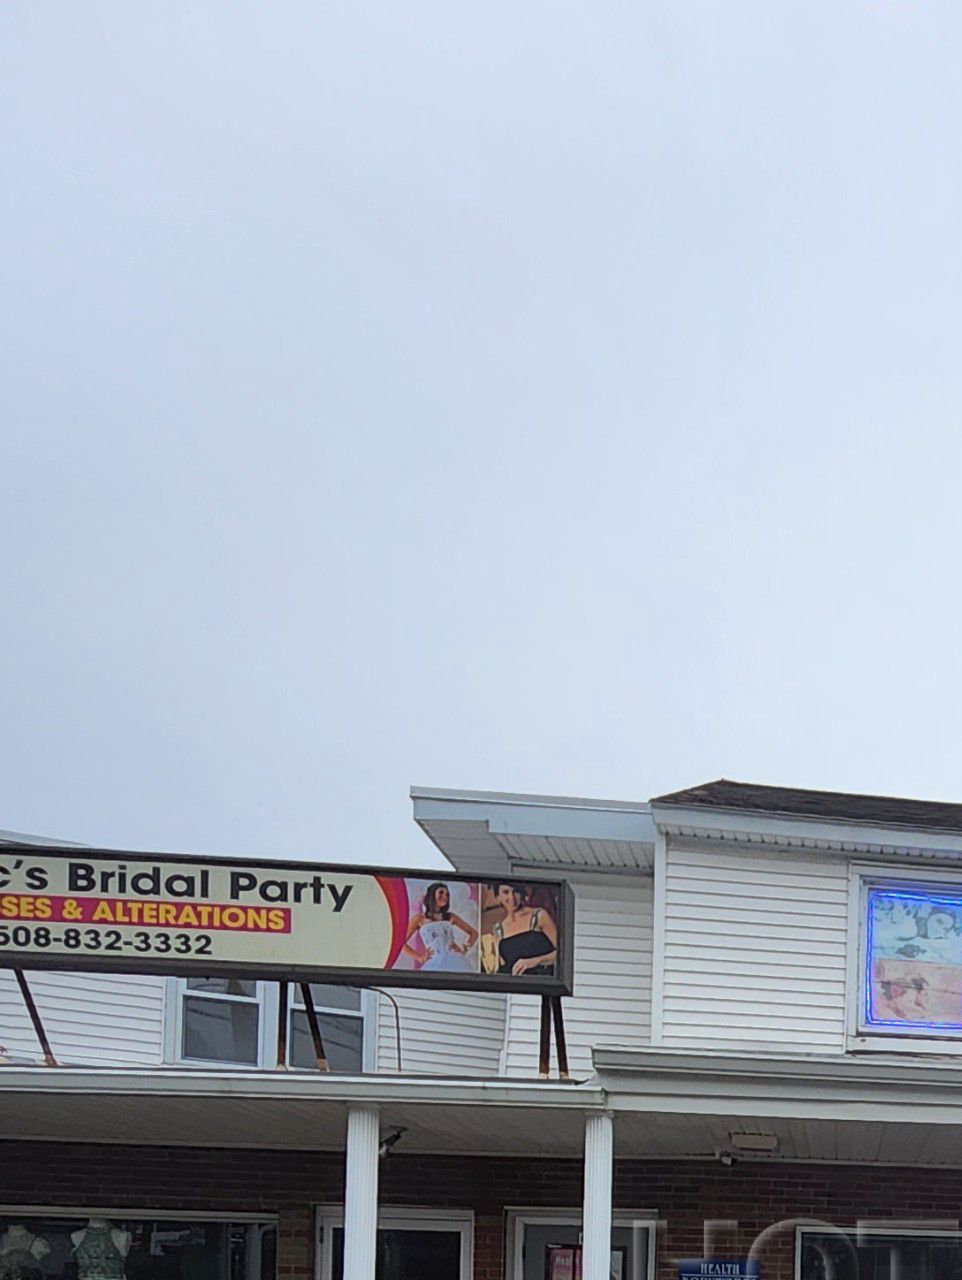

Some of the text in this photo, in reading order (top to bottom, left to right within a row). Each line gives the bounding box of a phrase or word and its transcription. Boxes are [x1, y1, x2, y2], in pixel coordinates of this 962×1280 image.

[68, 862, 209, 899] Bridal
[230, 871, 354, 912] Party
[62, 898, 84, 920] &
[92, 900, 285, 930] ALTERATIONS
[0, 925, 213, 956] 508-832-3332
[700, 1263, 740, 1275] HEALTH
